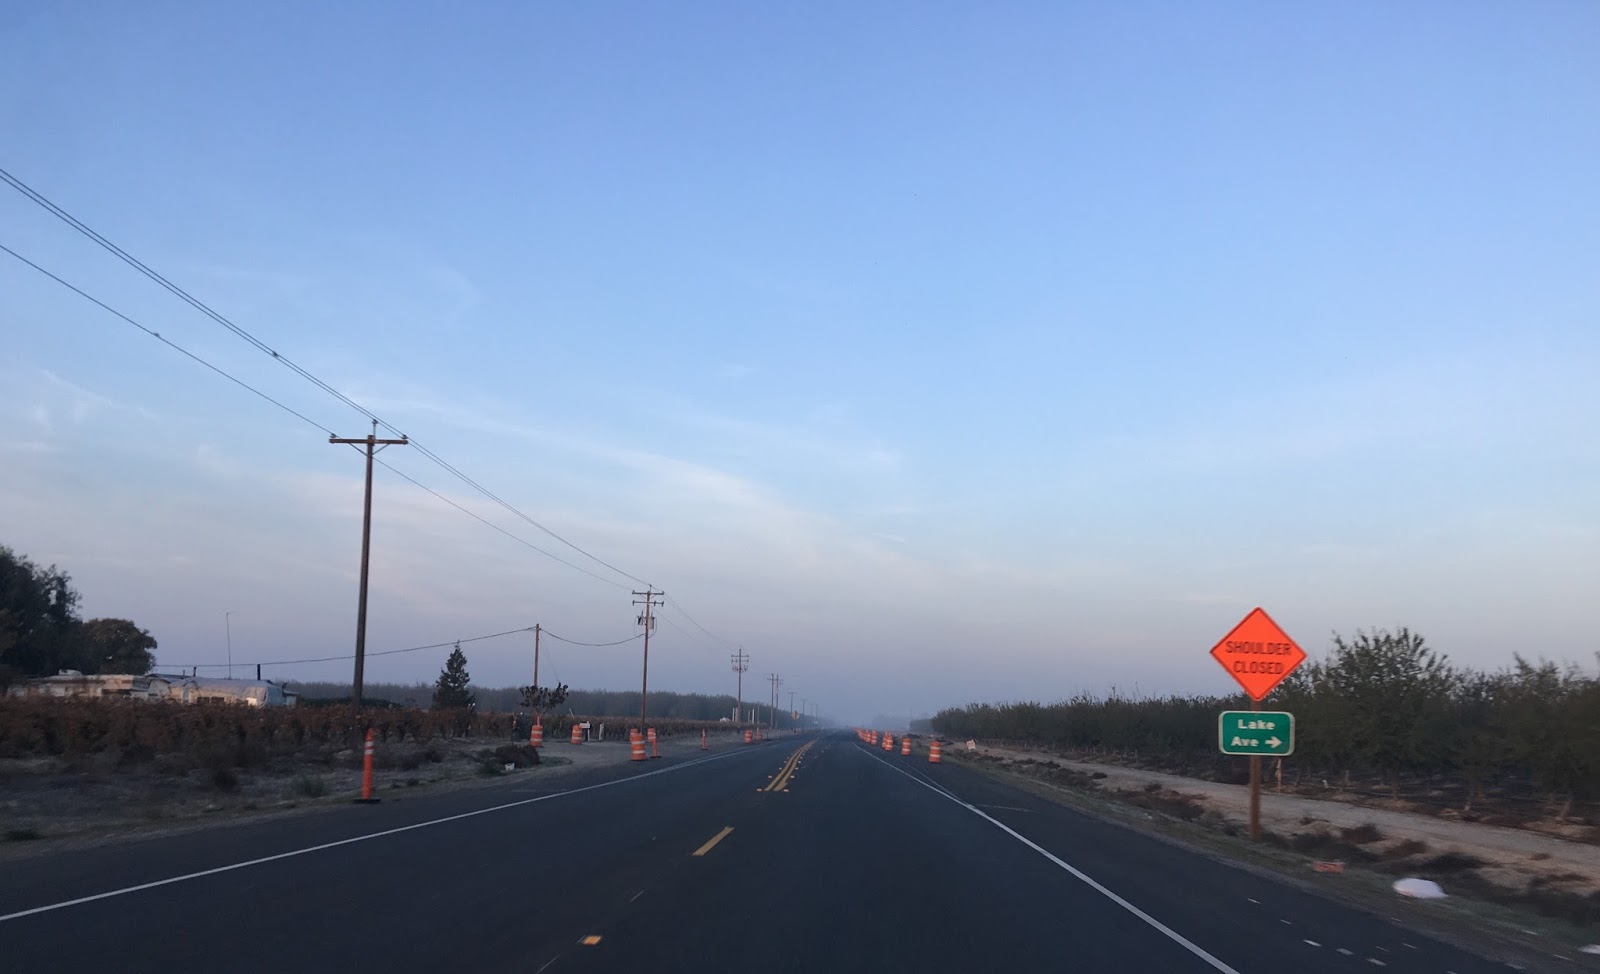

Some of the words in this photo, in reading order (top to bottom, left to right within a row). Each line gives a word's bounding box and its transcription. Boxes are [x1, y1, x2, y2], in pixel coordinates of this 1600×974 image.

[1225, 641, 1291, 655] SHOULDER
[1233, 661, 1284, 674] CLOSED
[1237, 719, 1276, 730] Lake
[1230, 736, 1259, 747] Ave
